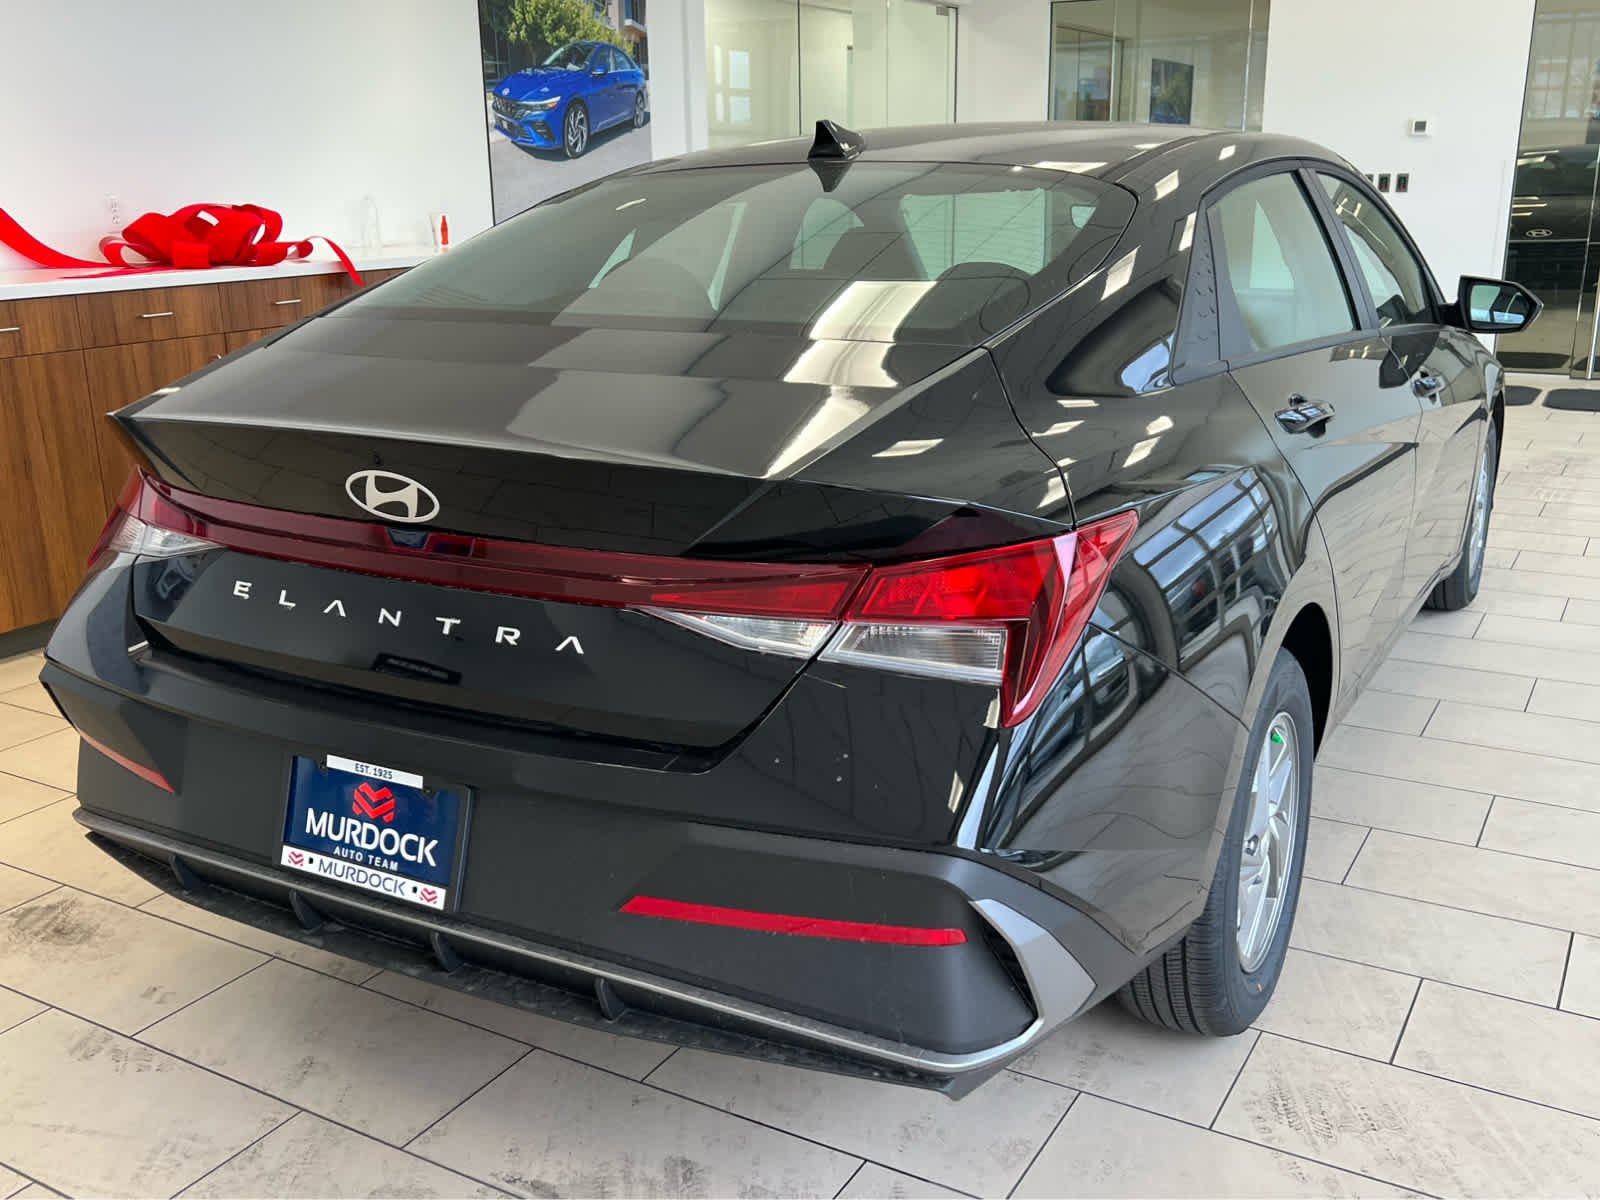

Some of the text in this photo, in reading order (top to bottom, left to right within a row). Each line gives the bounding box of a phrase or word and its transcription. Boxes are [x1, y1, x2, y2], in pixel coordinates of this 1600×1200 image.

[233, 580, 585, 654] ELANTRA
[354, 763, 393, 780] EST. 1925
[305, 808, 438, 867] MURDOCK
[318, 858, 406, 896] MURDOCK
[333, 846, 399, 872] AUTO TEAM
